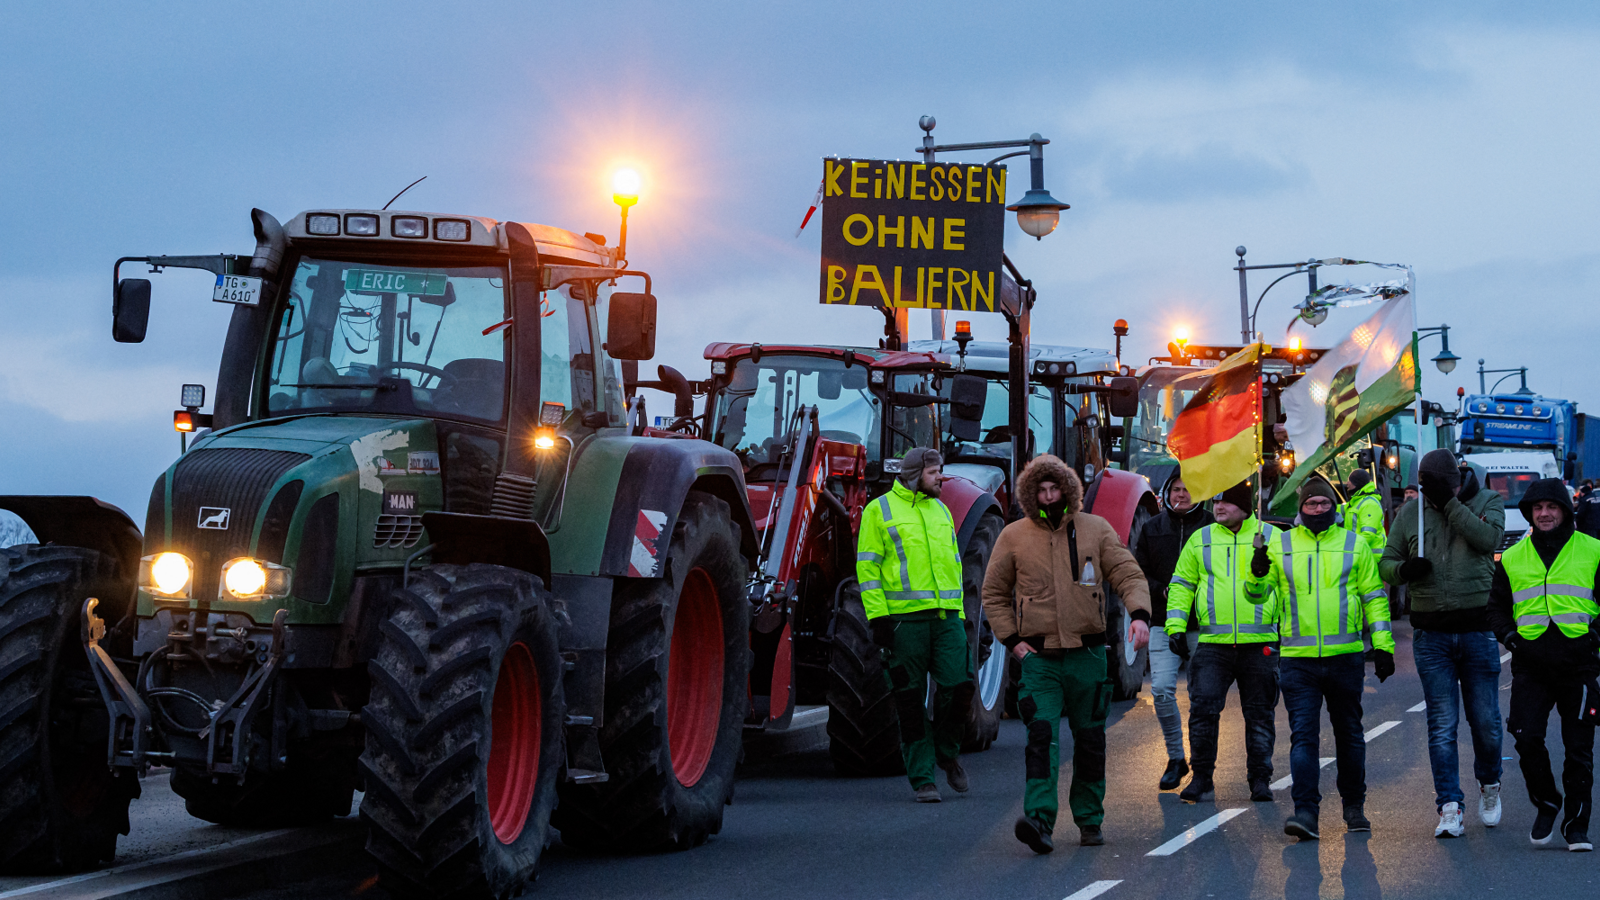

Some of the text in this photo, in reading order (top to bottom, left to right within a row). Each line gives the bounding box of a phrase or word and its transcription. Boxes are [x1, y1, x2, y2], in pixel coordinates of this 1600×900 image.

[842, 213, 966, 250] OHNE
[225, 276, 239, 289] TG
[361, 273, 405, 290] ERIC
[826, 264, 995, 313] BAUERN
[1486, 422, 1532, 430] STREAMLINE
[390, 494, 414, 509] MAN
